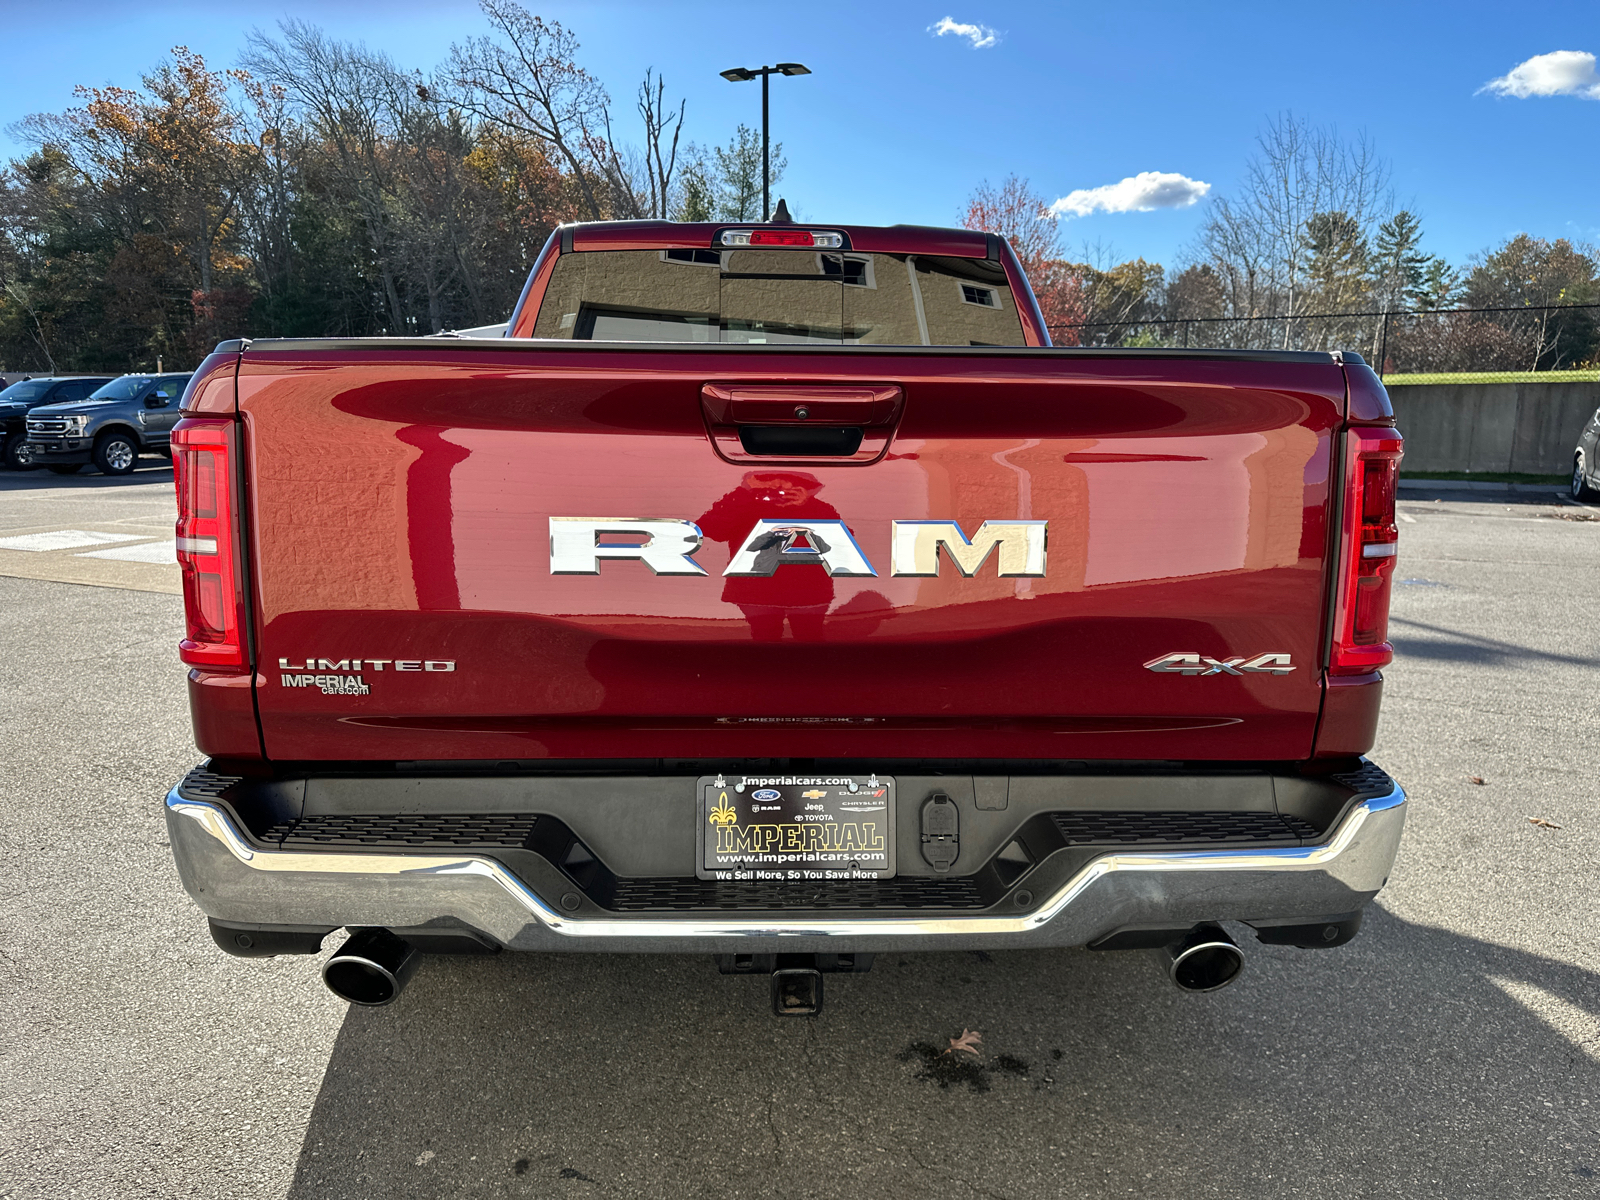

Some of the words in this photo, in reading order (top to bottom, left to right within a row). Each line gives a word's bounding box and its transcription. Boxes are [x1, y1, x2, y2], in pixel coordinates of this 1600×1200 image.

[549, 516, 1048, 577] RAM
[278, 657, 457, 672] LIMITED
[281, 674, 369, 688] IMPERIAL
[321, 686, 370, 695] cars.com
[742, 776, 852, 788] Imperialcars.com
[804, 803, 824, 812] Jeep
[716, 823, 884, 853] IMPERIAL
[716, 852, 885, 864] www.imperialcars.com
[716, 871, 732, 880] We
[734, 871, 754, 880] Sell
[756, 871, 785, 881] More,
[787, 871, 801, 880] So
[803, 871, 823, 879] You
[825, 871, 850, 879] Save
[852, 871, 878, 879] More
